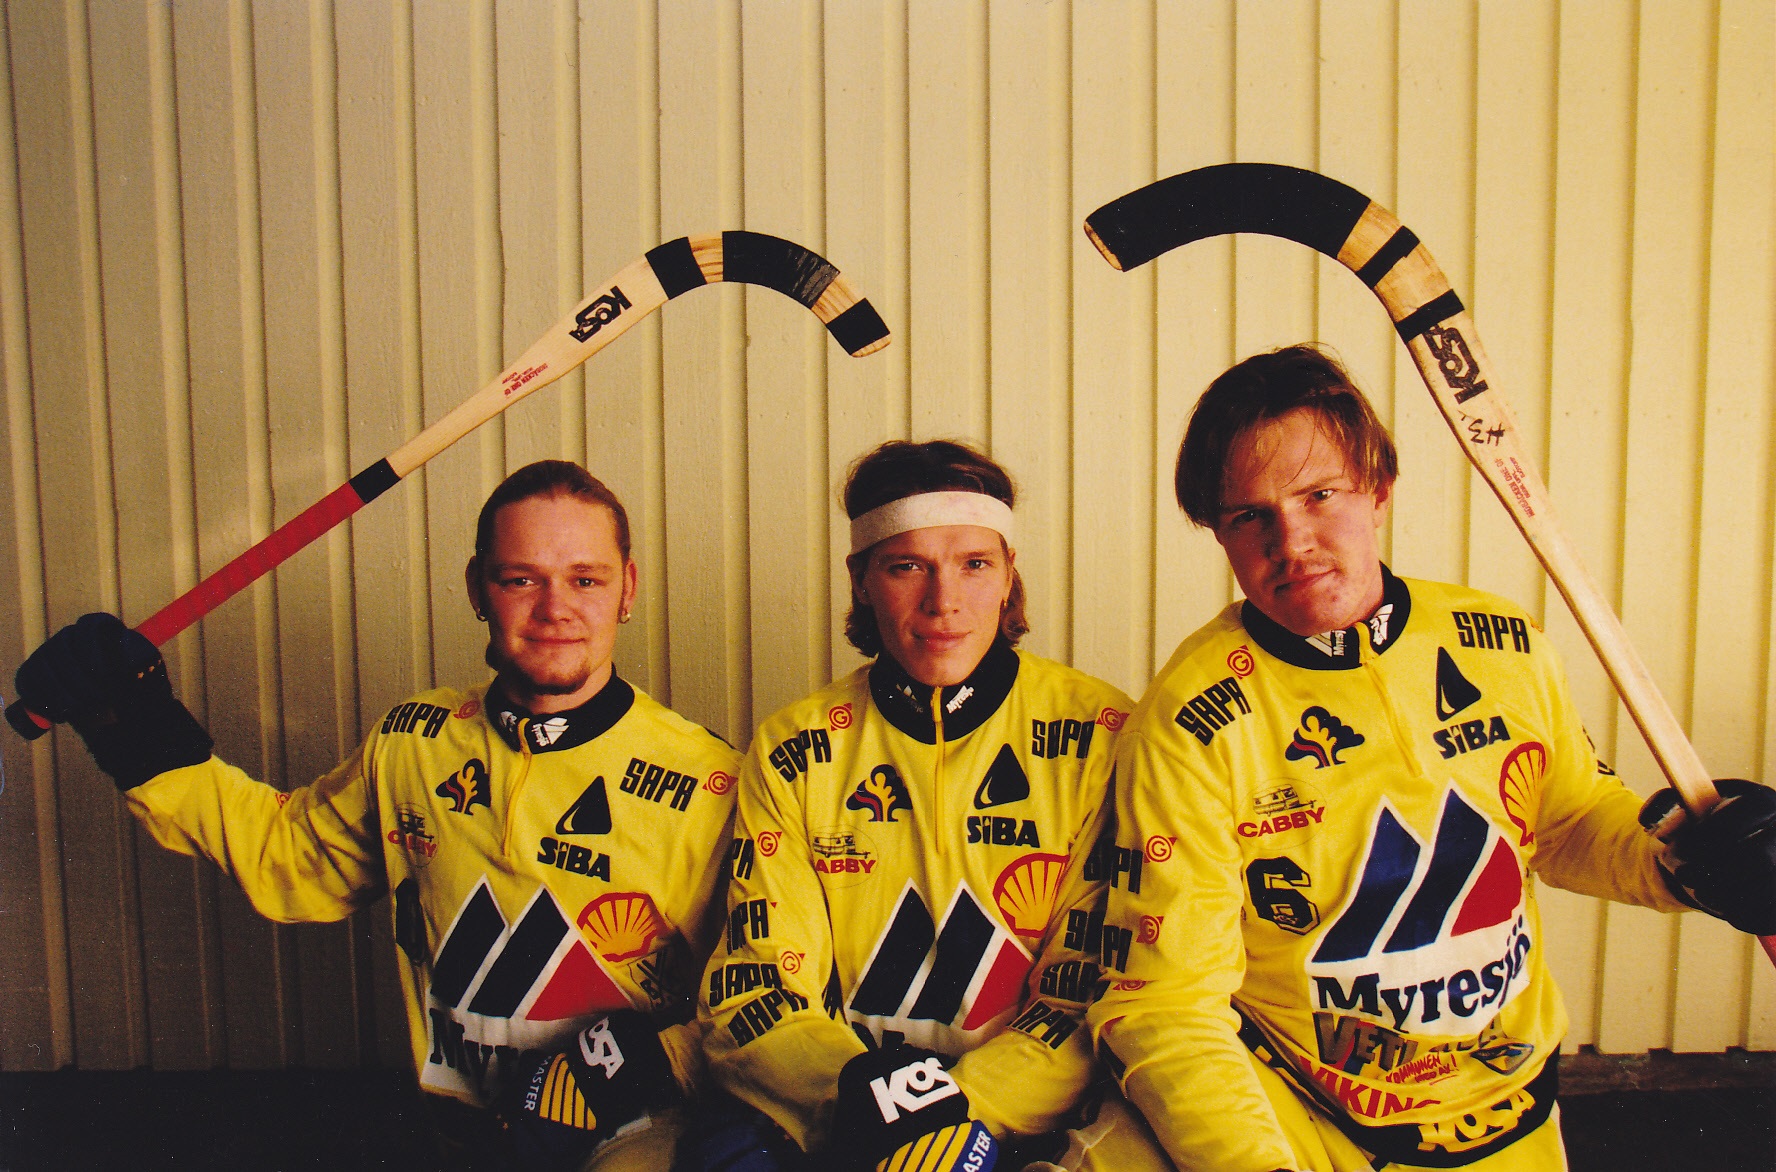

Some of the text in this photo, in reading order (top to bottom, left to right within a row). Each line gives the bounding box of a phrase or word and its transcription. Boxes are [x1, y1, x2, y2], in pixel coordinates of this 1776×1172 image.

[1452, 611, 1530, 654] SAPA
[381, 702, 451, 738] SAPA
[1174, 676, 1252, 746] SAPA
[768, 728, 832, 783] SAPA
[620, 757, 699, 812] SAPA
[1237, 807, 1325, 838] CABBY
[815, 858, 876, 874] ABBY
[1246, 856, 1320, 936] 6
[1312, 914, 1531, 1034] Myresjö
[961, 1129, 992, 1172] ASTER
